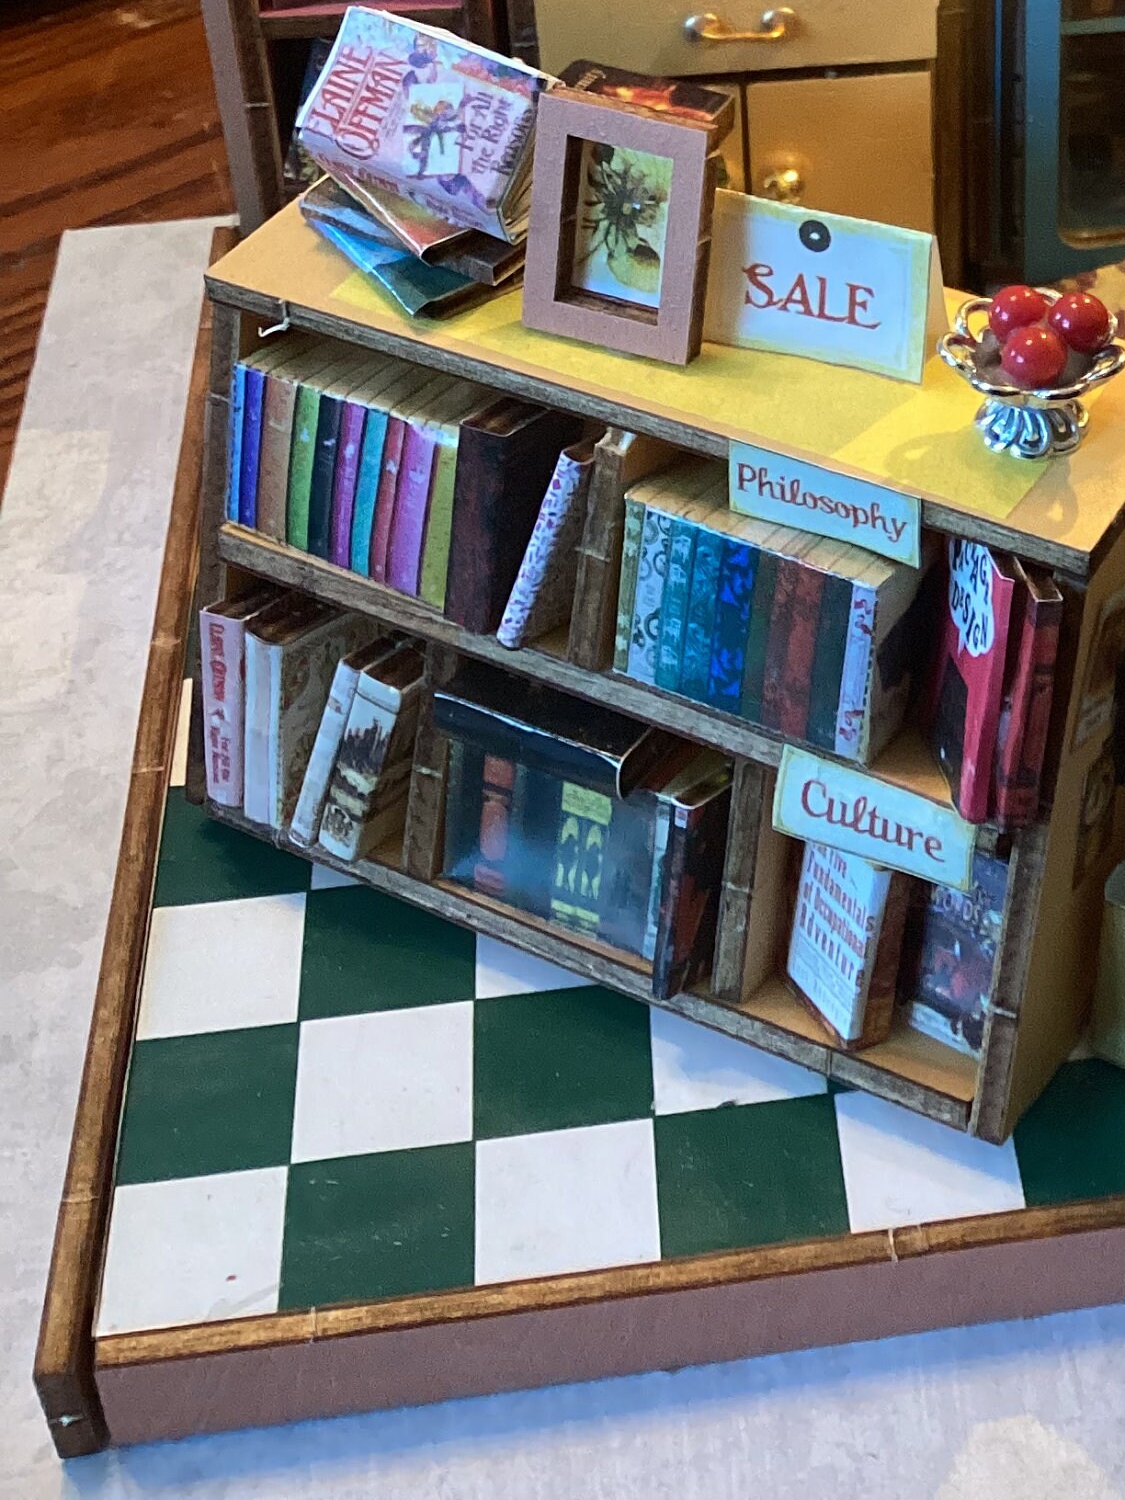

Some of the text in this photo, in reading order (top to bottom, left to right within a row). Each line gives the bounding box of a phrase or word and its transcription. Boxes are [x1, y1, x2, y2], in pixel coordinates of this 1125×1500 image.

[470, 91, 494, 117] All
[482, 97, 514, 143] Right
[743, 264, 881, 330] SALE
[737, 463, 908, 543] Philosophy
[951, 580, 989, 650] DESIGN
[801, 779, 946, 863] Culture
[800, 903, 865, 990] Adventure
